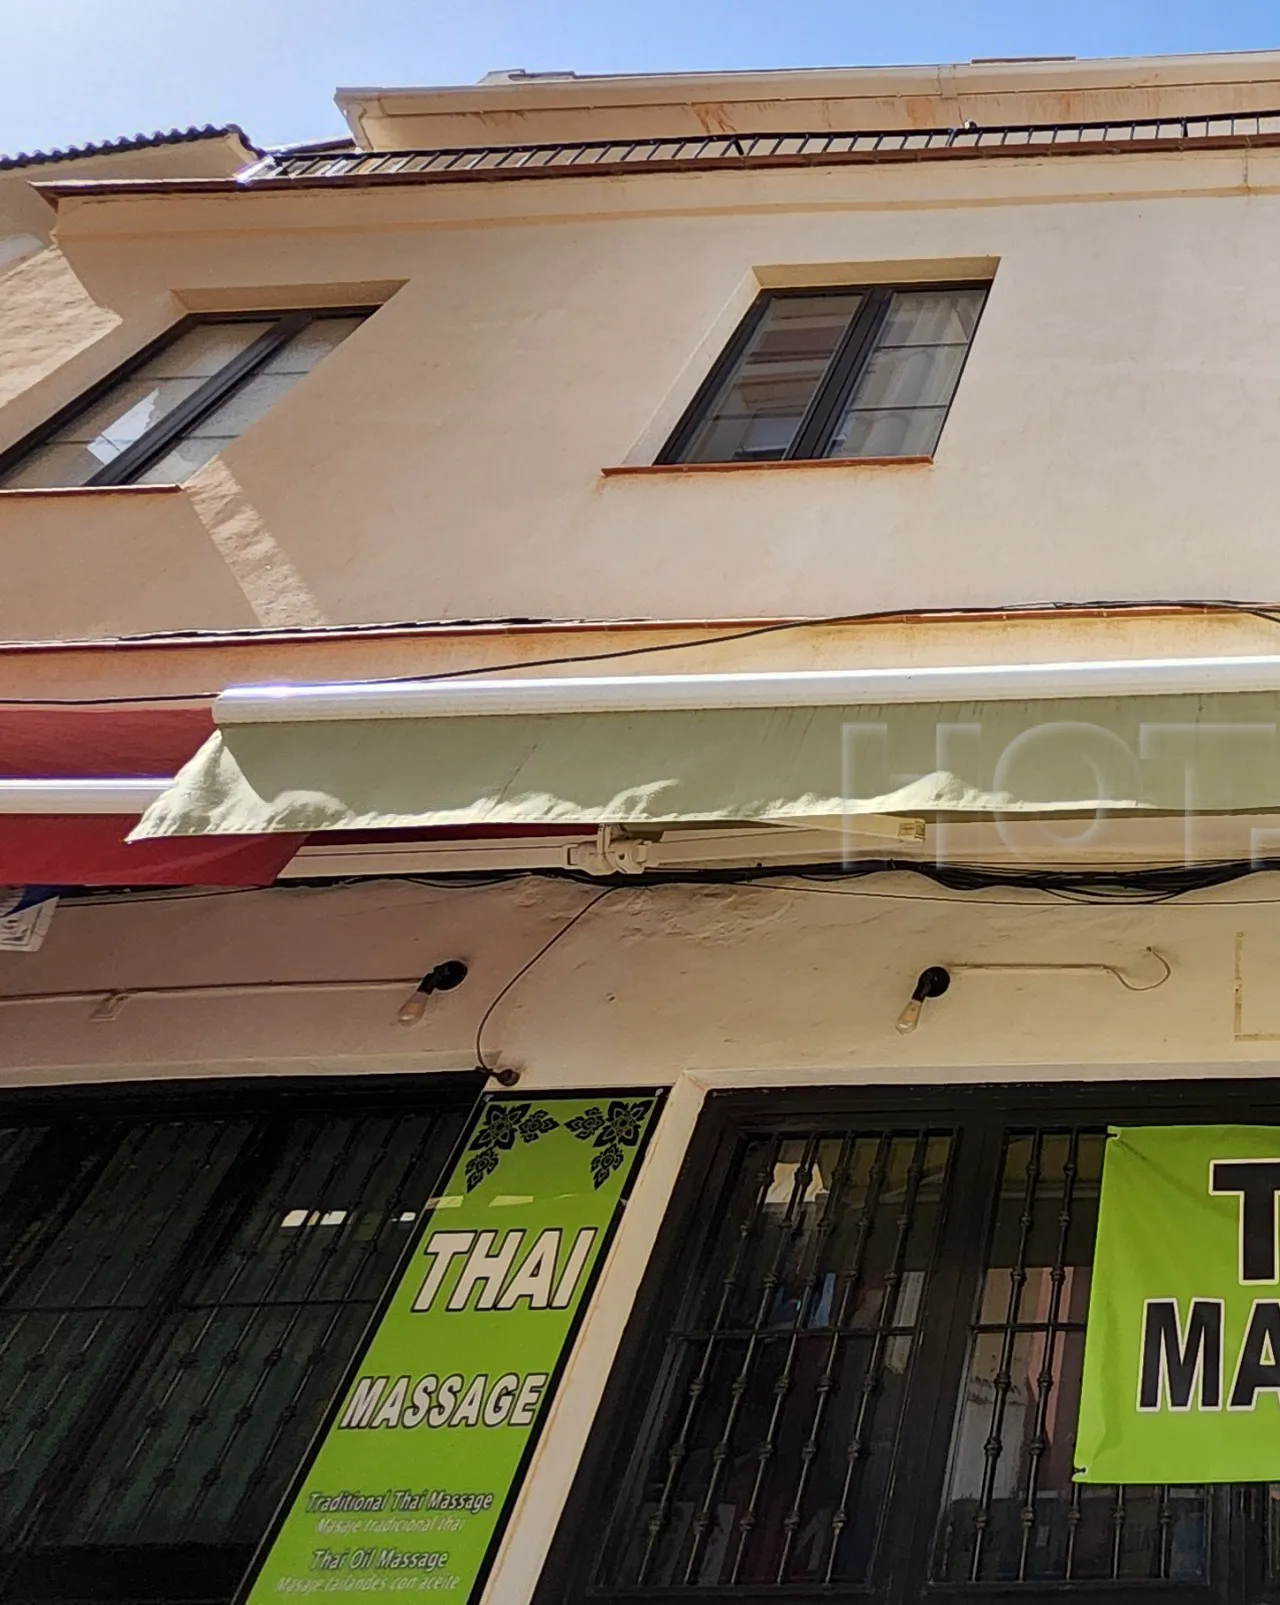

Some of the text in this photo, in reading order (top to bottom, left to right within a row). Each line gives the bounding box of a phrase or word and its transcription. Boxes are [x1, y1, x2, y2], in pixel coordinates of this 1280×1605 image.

[411, 1228, 598, 1313] THAI
[338, 1373, 549, 1429] MASSAGE
[307, 1489, 495, 1514] Traditional Thai Massage
[316, 1516, 360, 1536] Masaje
[363, 1516, 434, 1533] tradicional
[310, 1549, 449, 1572] Thai Oil Massage
